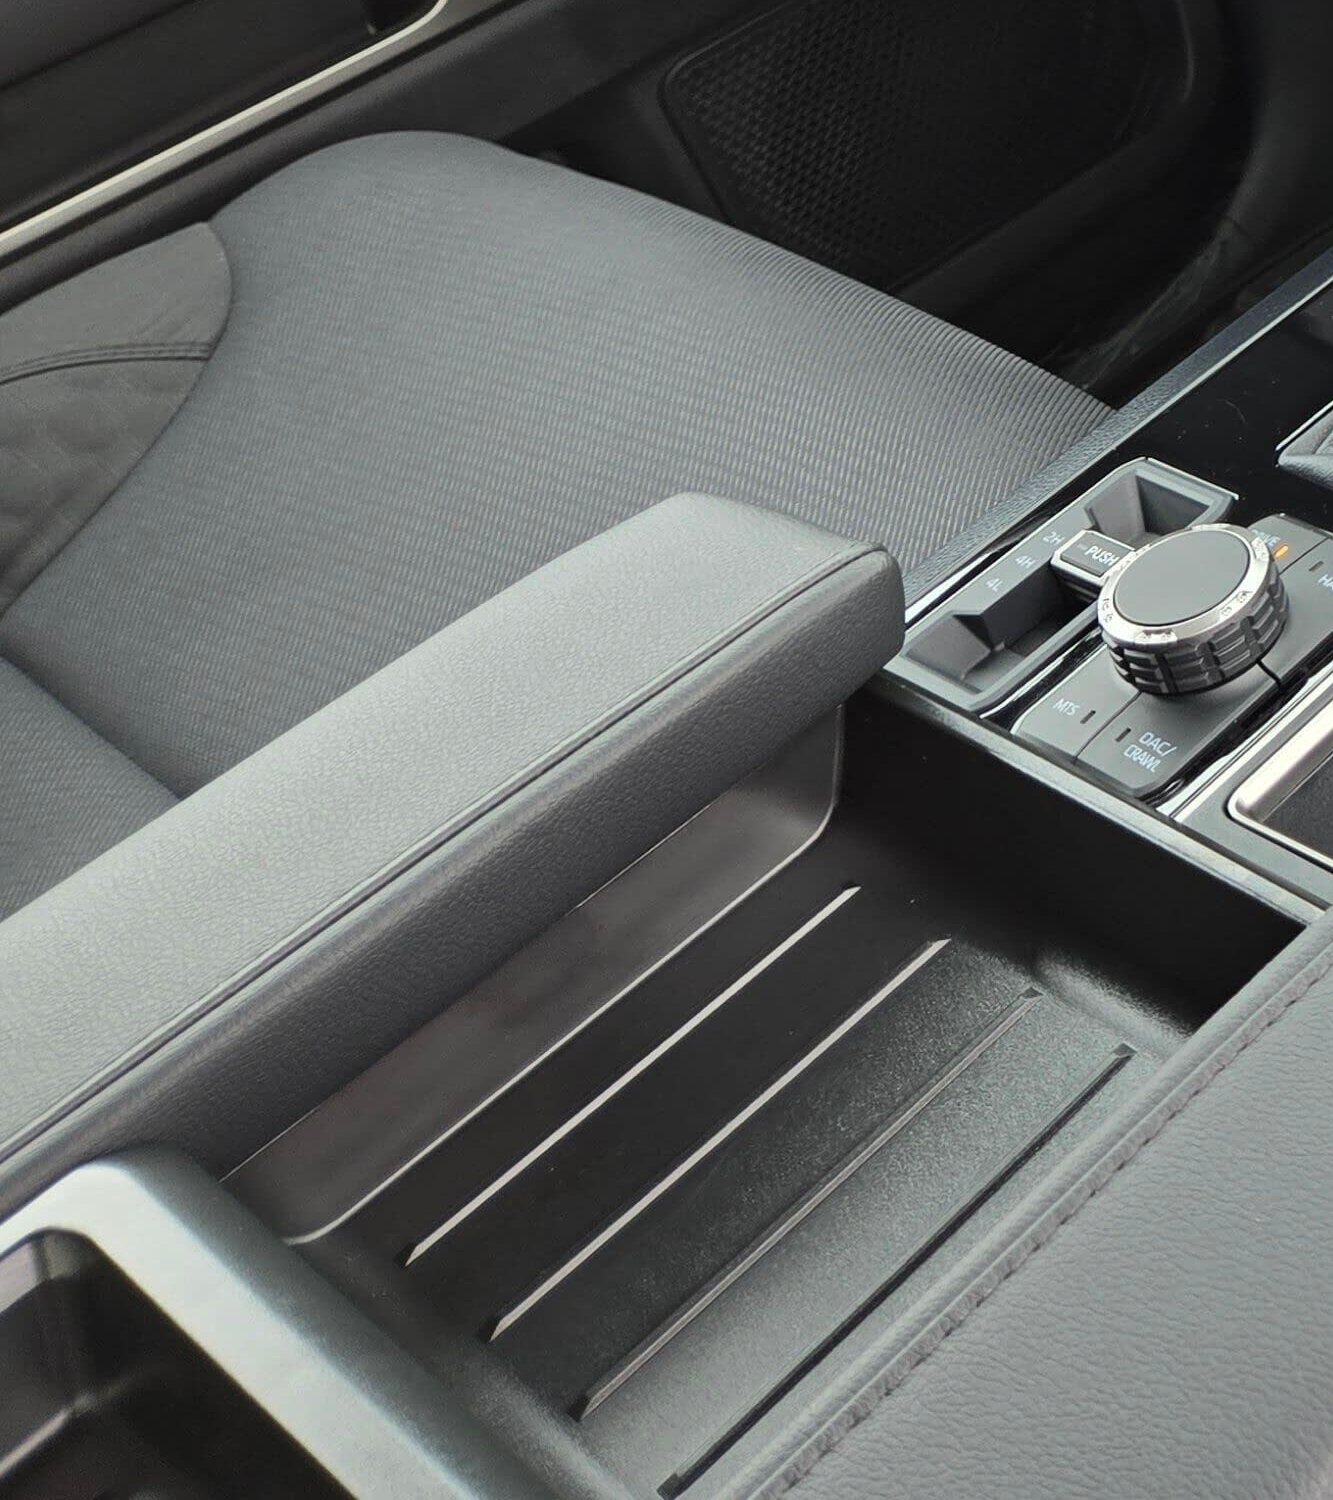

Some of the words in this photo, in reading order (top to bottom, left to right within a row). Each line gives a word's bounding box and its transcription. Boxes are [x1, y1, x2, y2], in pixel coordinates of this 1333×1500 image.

[1043, 531, 1066, 546] 2H
[1014, 555, 1037, 568] 4H
[1084, 545, 1121, 566] PUSH
[986, 578, 1003, 592] 4L
[1052, 698, 1080, 716] MTS
[1139, 731, 1178, 757] DAC/
[1123, 744, 1162, 773] CRAWL
